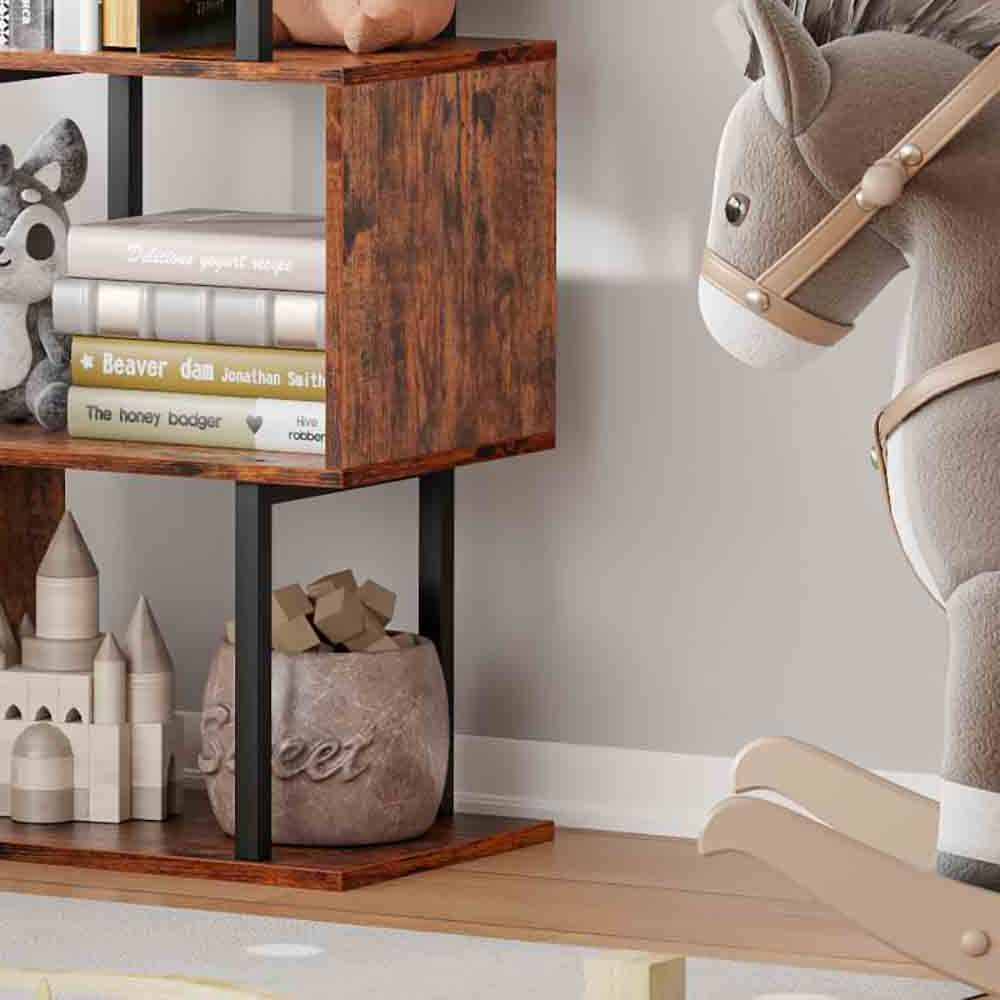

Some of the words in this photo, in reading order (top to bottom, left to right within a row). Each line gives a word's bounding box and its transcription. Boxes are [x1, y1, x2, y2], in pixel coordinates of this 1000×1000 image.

[103, 352, 168, 378] Beaver
[180, 357, 215, 382] dam
[221, 367, 281, 386] Jonathan
[86, 405, 112, 421] The
[119, 407, 161, 426] honey
[168, 409, 223, 430] badger
